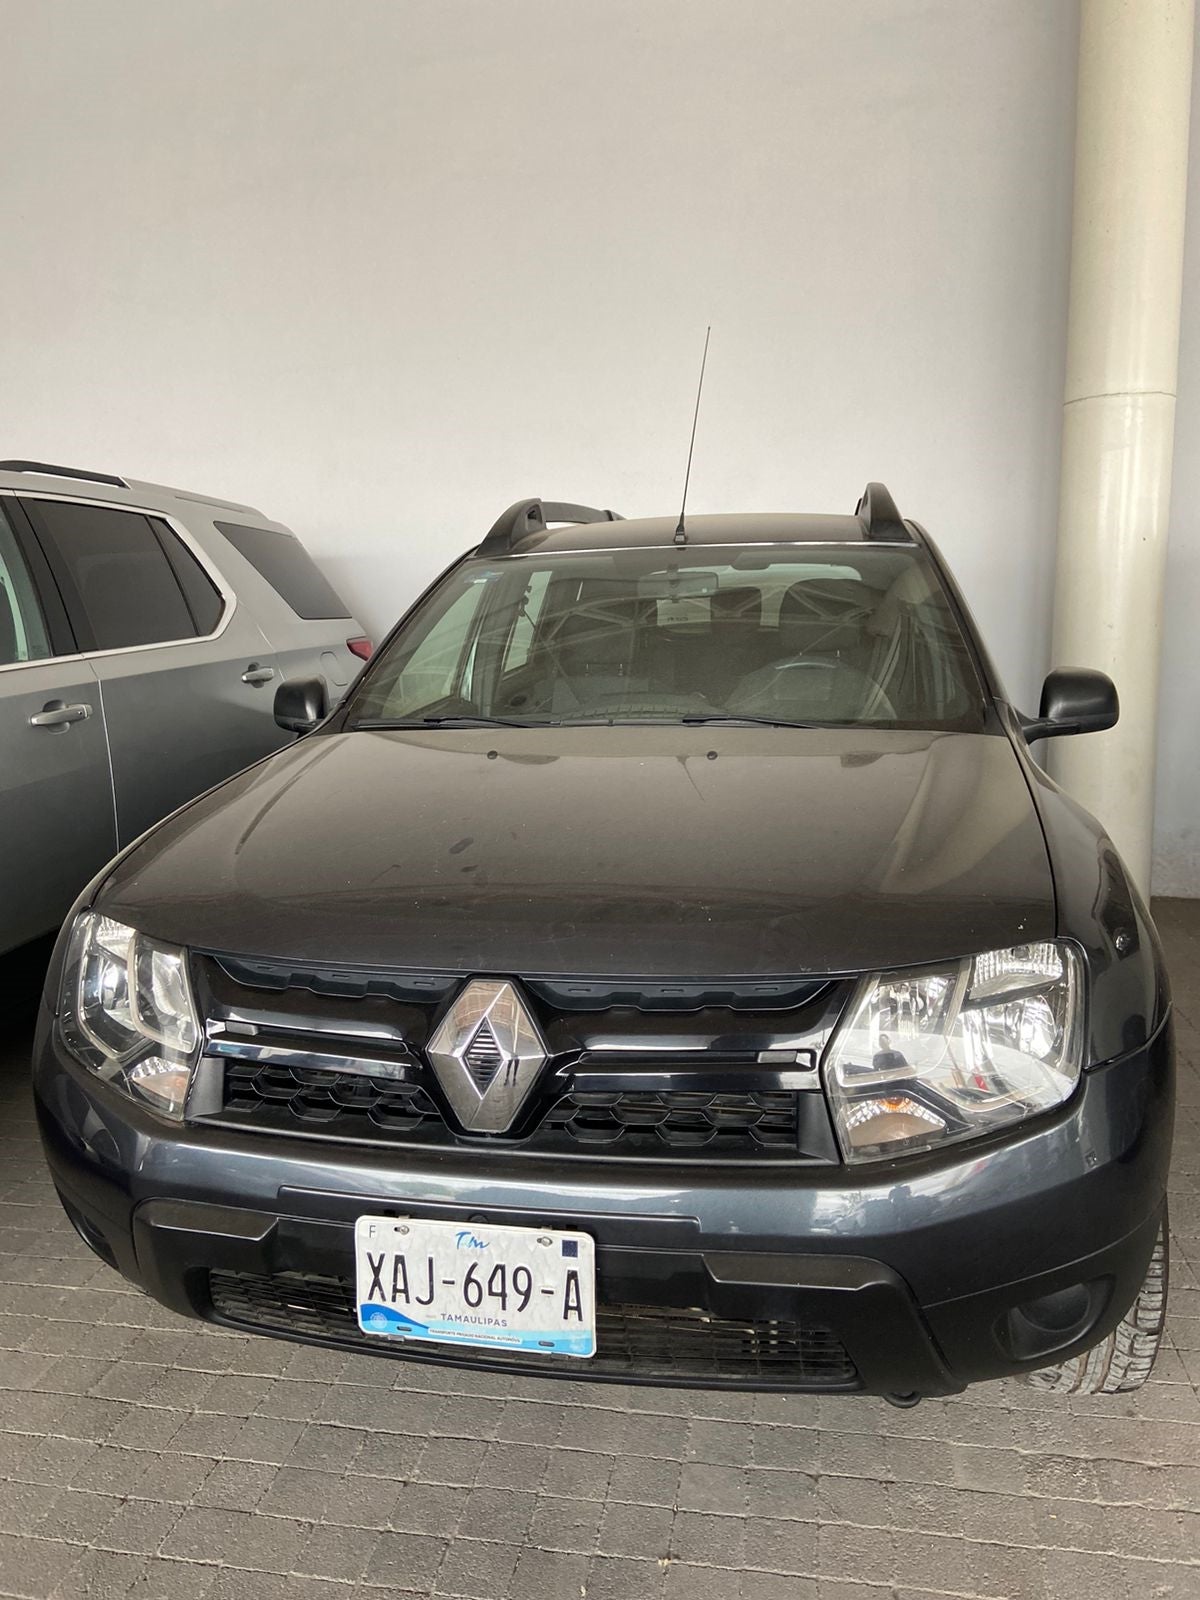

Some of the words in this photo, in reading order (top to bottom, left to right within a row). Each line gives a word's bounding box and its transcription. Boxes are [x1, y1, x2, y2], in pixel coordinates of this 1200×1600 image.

[368, 1224, 376, 1239] F
[366, 1251, 583, 1322] XAJ-649-A
[440, 1313, 508, 1327] TAMAULIPAS
